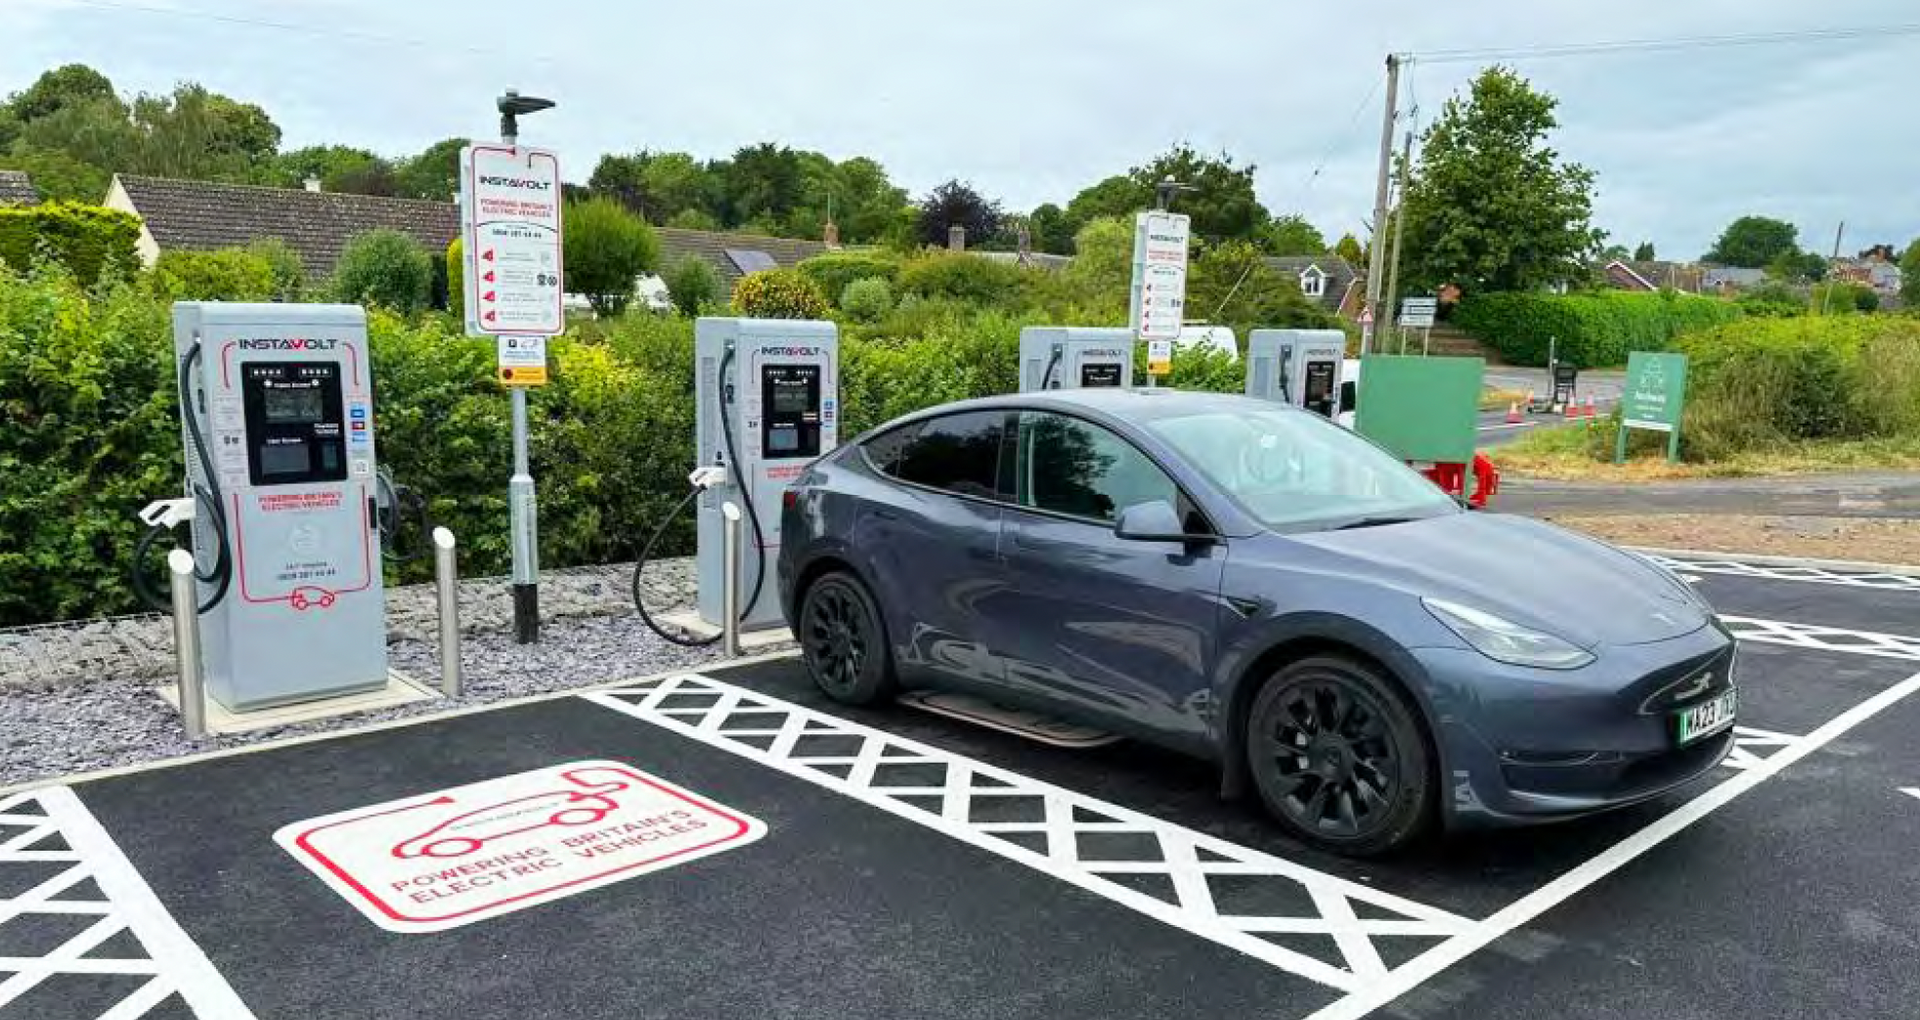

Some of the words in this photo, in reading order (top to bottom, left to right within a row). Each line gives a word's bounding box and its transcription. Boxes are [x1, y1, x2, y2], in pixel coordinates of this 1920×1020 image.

[479, 176, 551, 190] INSTAVOLT
[239, 339, 338, 350] INSTAVOLT
[761, 346, 821, 356] INSTAVOLT
[391, 847, 549, 892] POWERING
[561, 810, 691, 848] BRITAIN'S
[409, 858, 564, 904] ELECTRIC
[573, 819, 708, 858] VEHICLES
